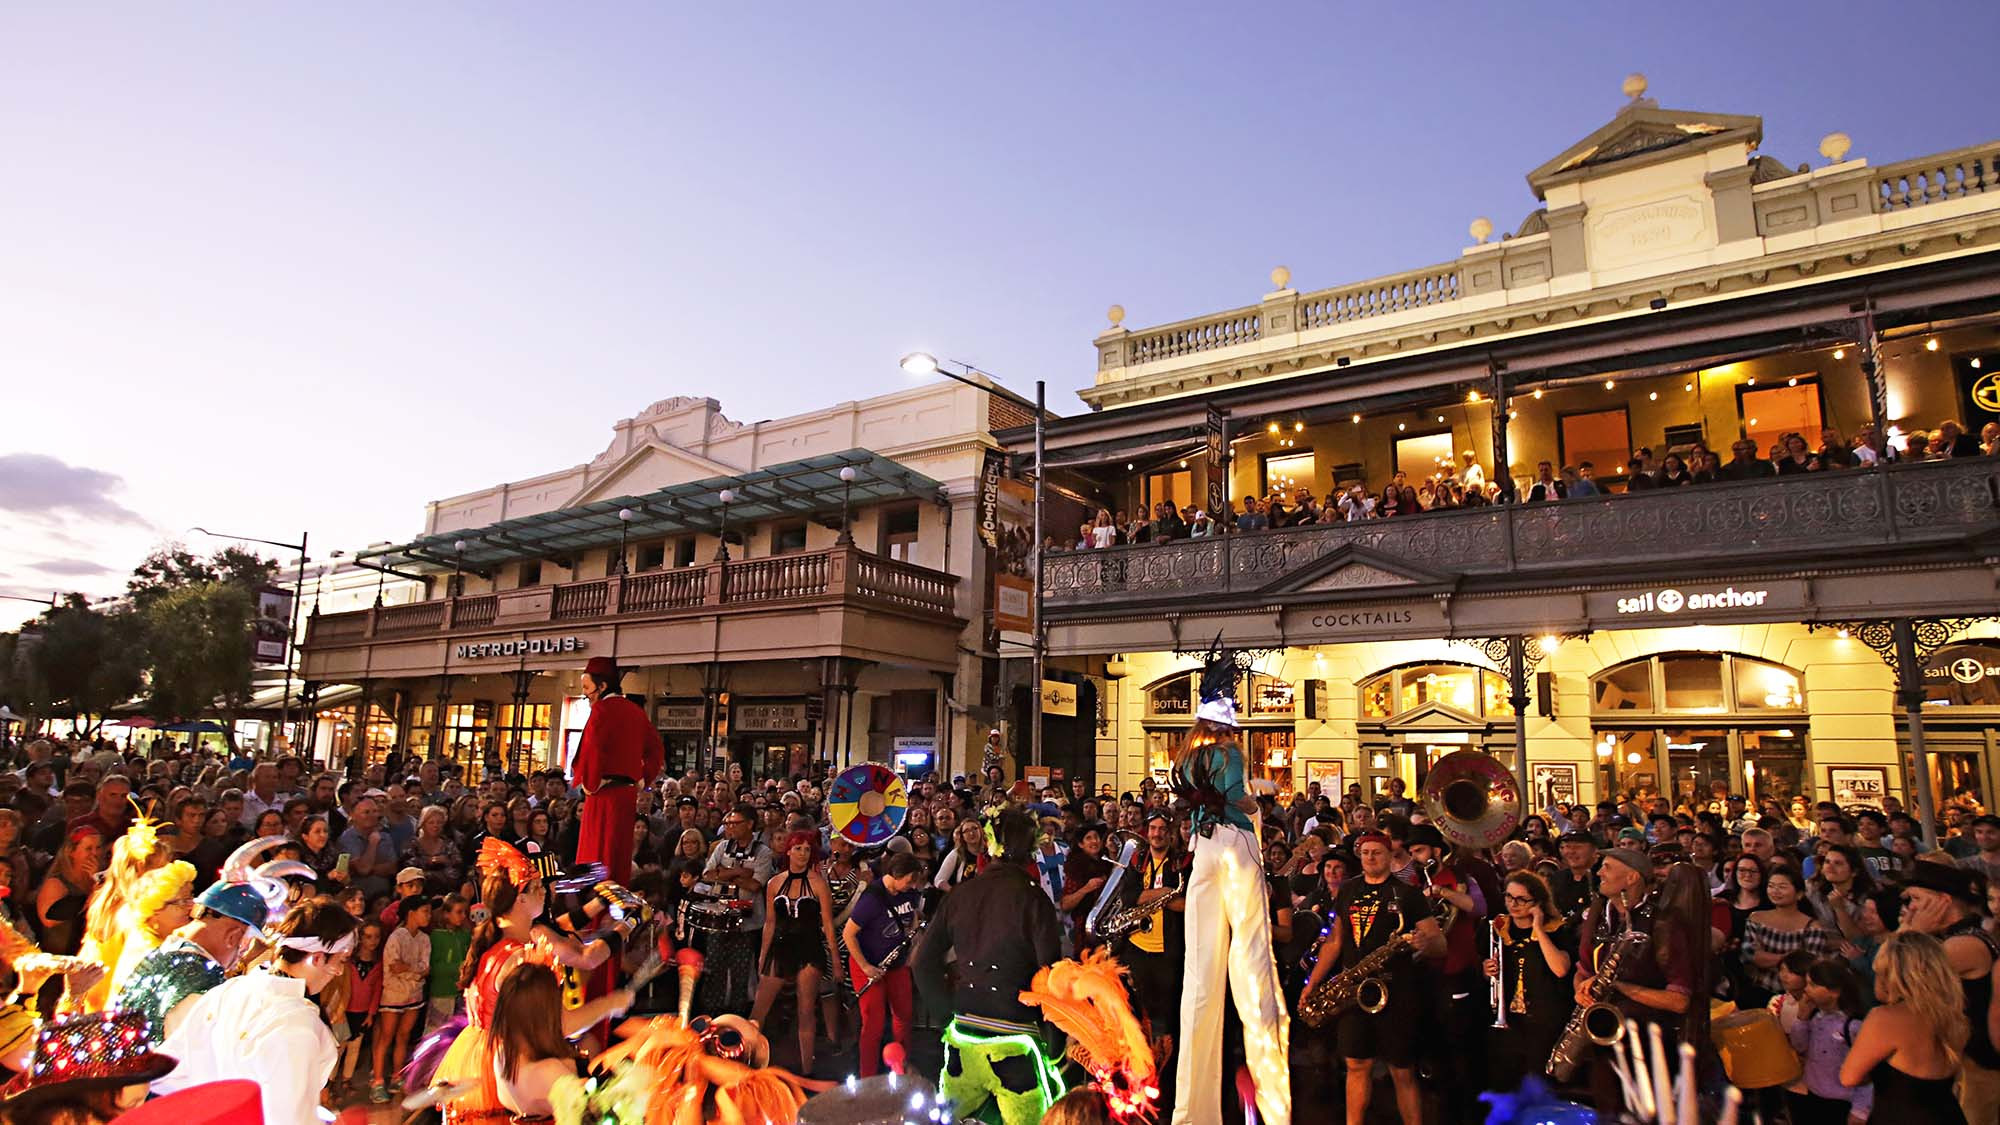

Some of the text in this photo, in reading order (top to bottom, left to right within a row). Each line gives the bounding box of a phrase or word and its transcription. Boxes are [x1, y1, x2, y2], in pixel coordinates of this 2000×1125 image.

[1616, 588, 1767, 613] sail anchor
[1312, 610, 1412, 628] COCKTAILS
[457, 636, 577, 659] METROPOLIS
[1924, 666, 1949, 678] sail
[1153, 699, 1188, 710] BOTTLE
[1261, 697, 1290, 707] SHOP
[1435, 815, 1474, 844] Brass
